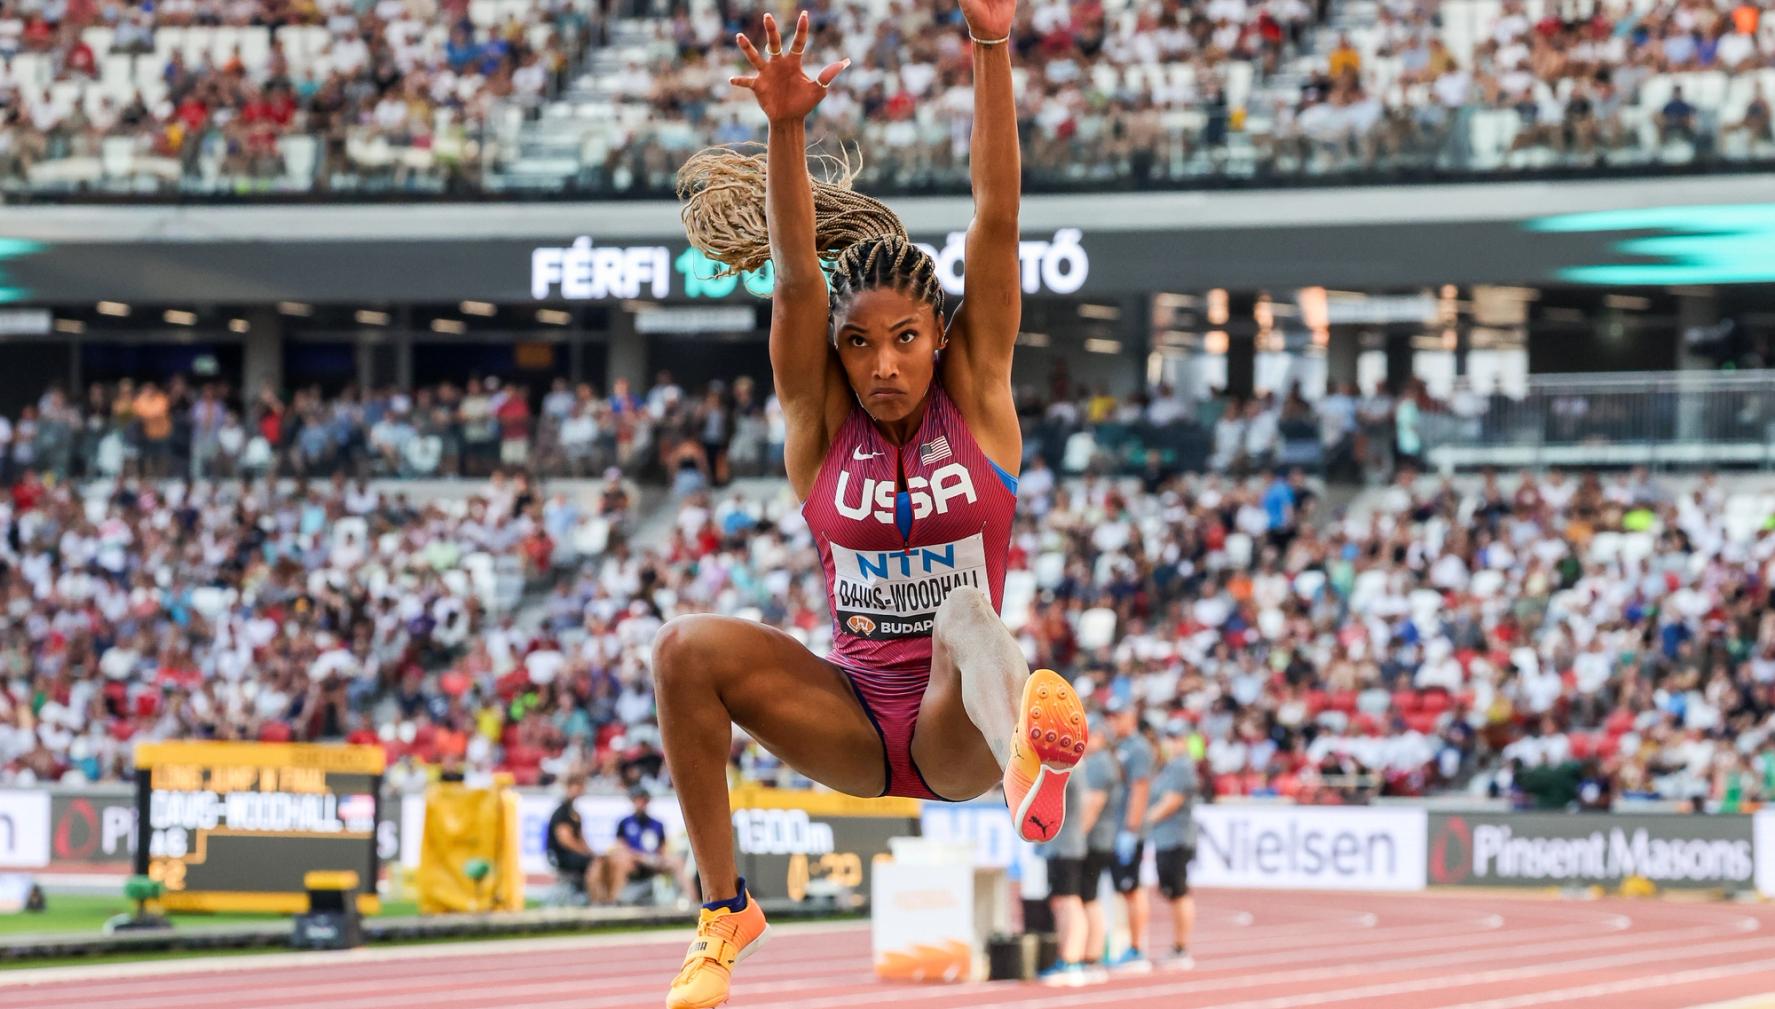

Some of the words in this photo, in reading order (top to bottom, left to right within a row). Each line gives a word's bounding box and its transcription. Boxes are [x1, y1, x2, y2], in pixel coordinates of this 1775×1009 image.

[531, 235, 670, 299] FÉRFI
[834, 462, 977, 524] USA
[855, 543, 955, 581] NTN
[880, 619, 934, 634] BUDAP
[1197, 818, 1396, 874] Nielsen
[1472, 824, 1605, 879] Pinsent
[1606, 826, 1752, 881] Masons
